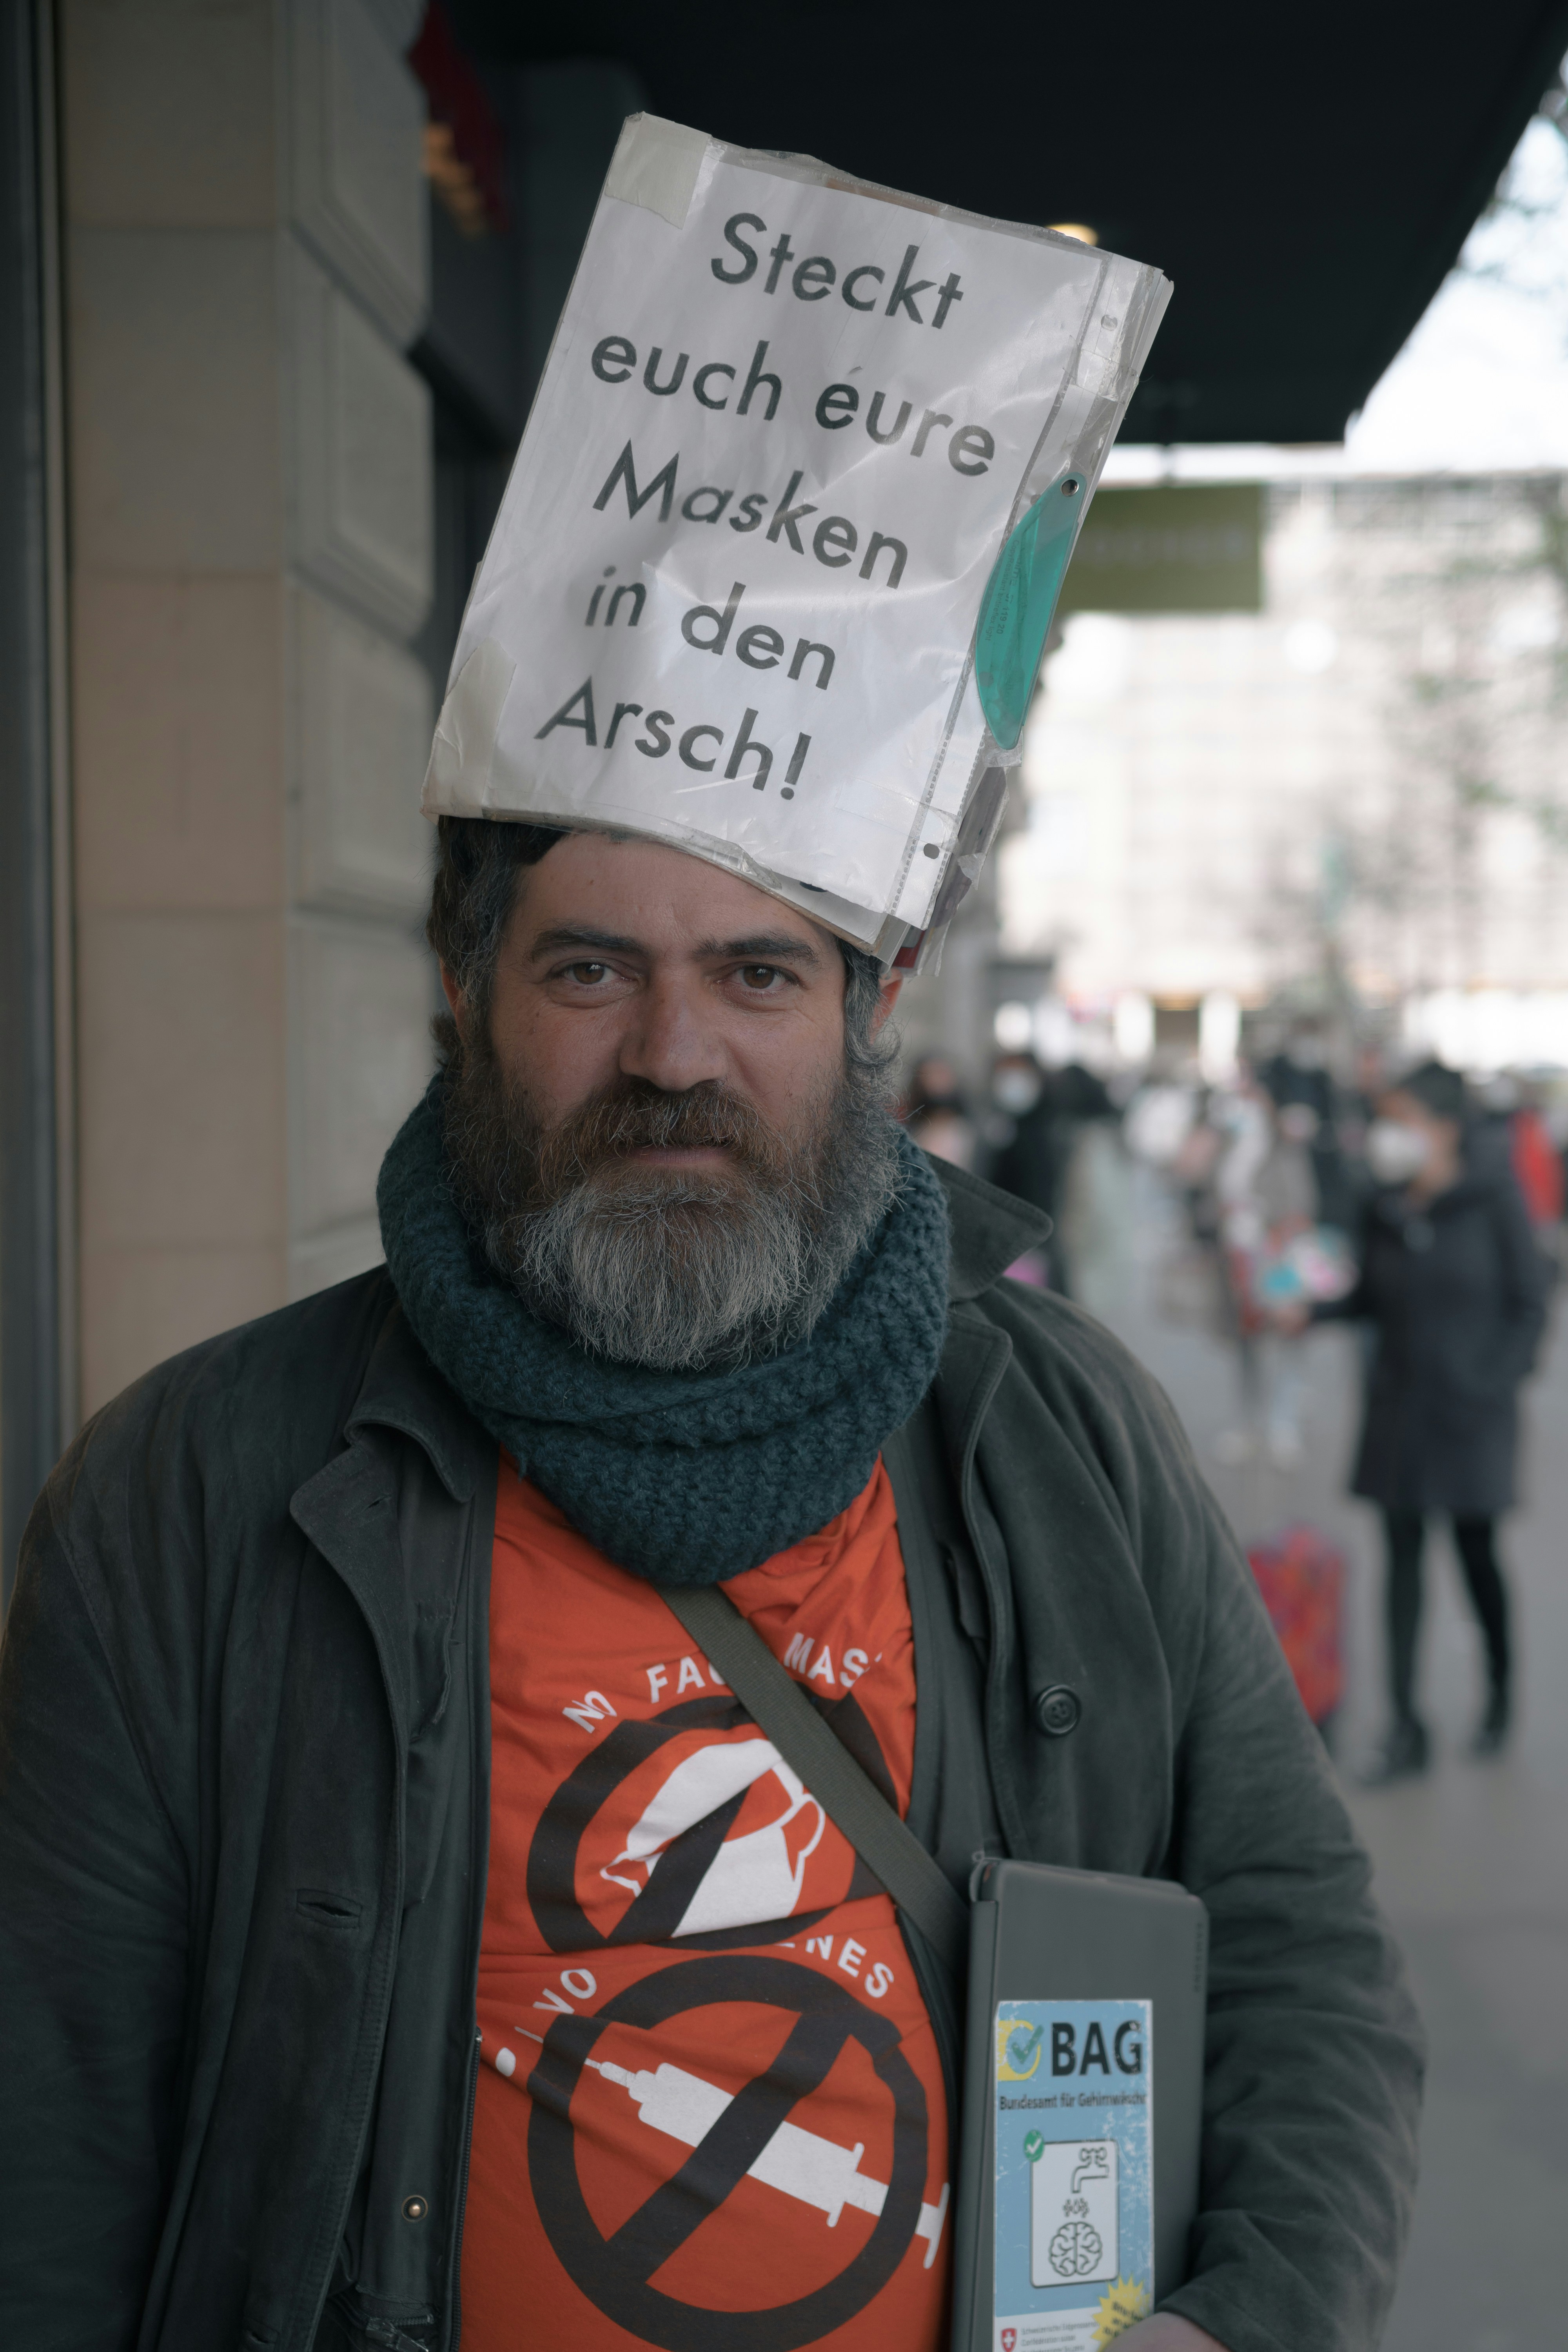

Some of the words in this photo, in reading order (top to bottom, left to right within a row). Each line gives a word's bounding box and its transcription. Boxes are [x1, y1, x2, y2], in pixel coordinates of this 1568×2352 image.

[711, 213, 964, 329] Steckt
[592, 336, 782, 421] euch
[815, 383, 995, 477] eure
[593, 440, 907, 589] Masken
[585, 566, 646, 626] in
[681, 581, 835, 690] den
[985, 626, 995, 641] light
[996, 624, 1005, 634] 20
[534, 676, 811, 800] Arsch!
[562, 1690, 617, 1733] NO
[784, 1632, 883, 1688] MAS
[1000, 2094, 1058, 2111] Bundesamt
[1060, 2092, 1076, 2108] für
[1051, 2020, 1142, 2076] BAG
